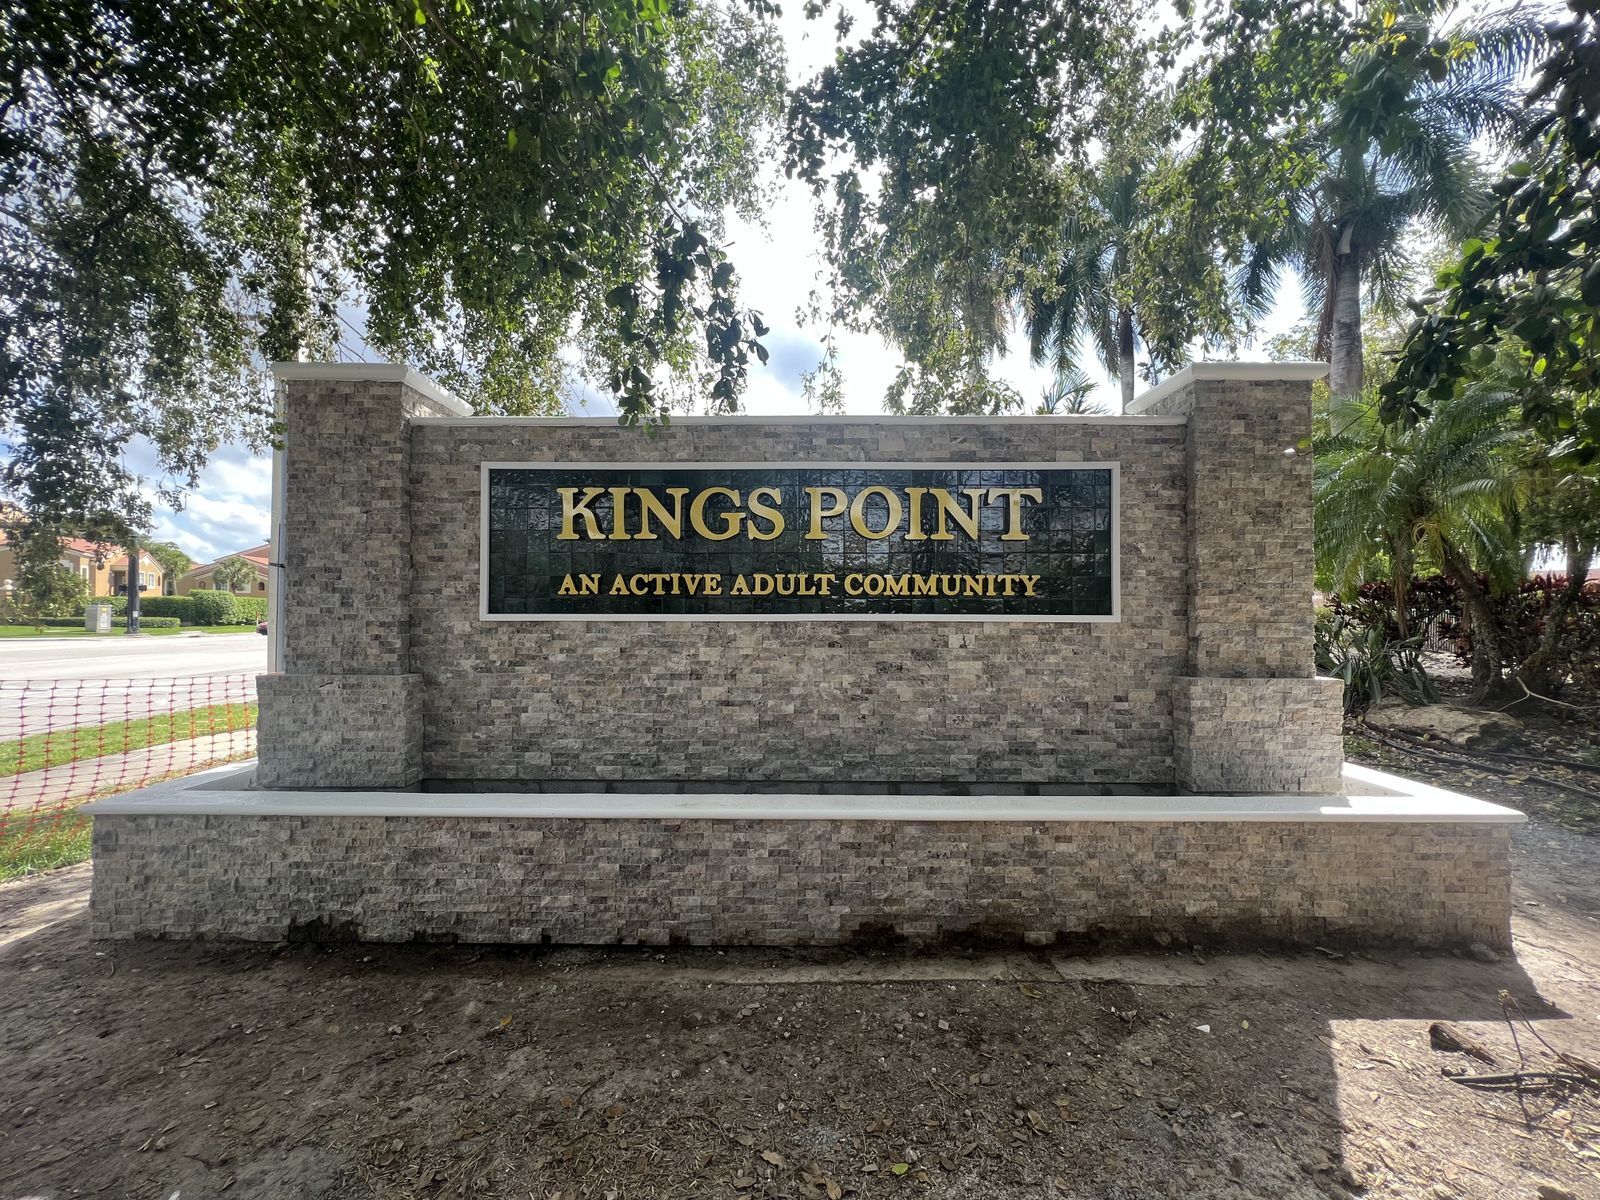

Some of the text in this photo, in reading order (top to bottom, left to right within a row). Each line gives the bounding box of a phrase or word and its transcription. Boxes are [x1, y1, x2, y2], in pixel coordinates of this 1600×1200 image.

[556, 486, 1042, 541] KINGS POINT
[557, 573, 1041, 597] AN ACTIVE ADULT COMMUNITY
